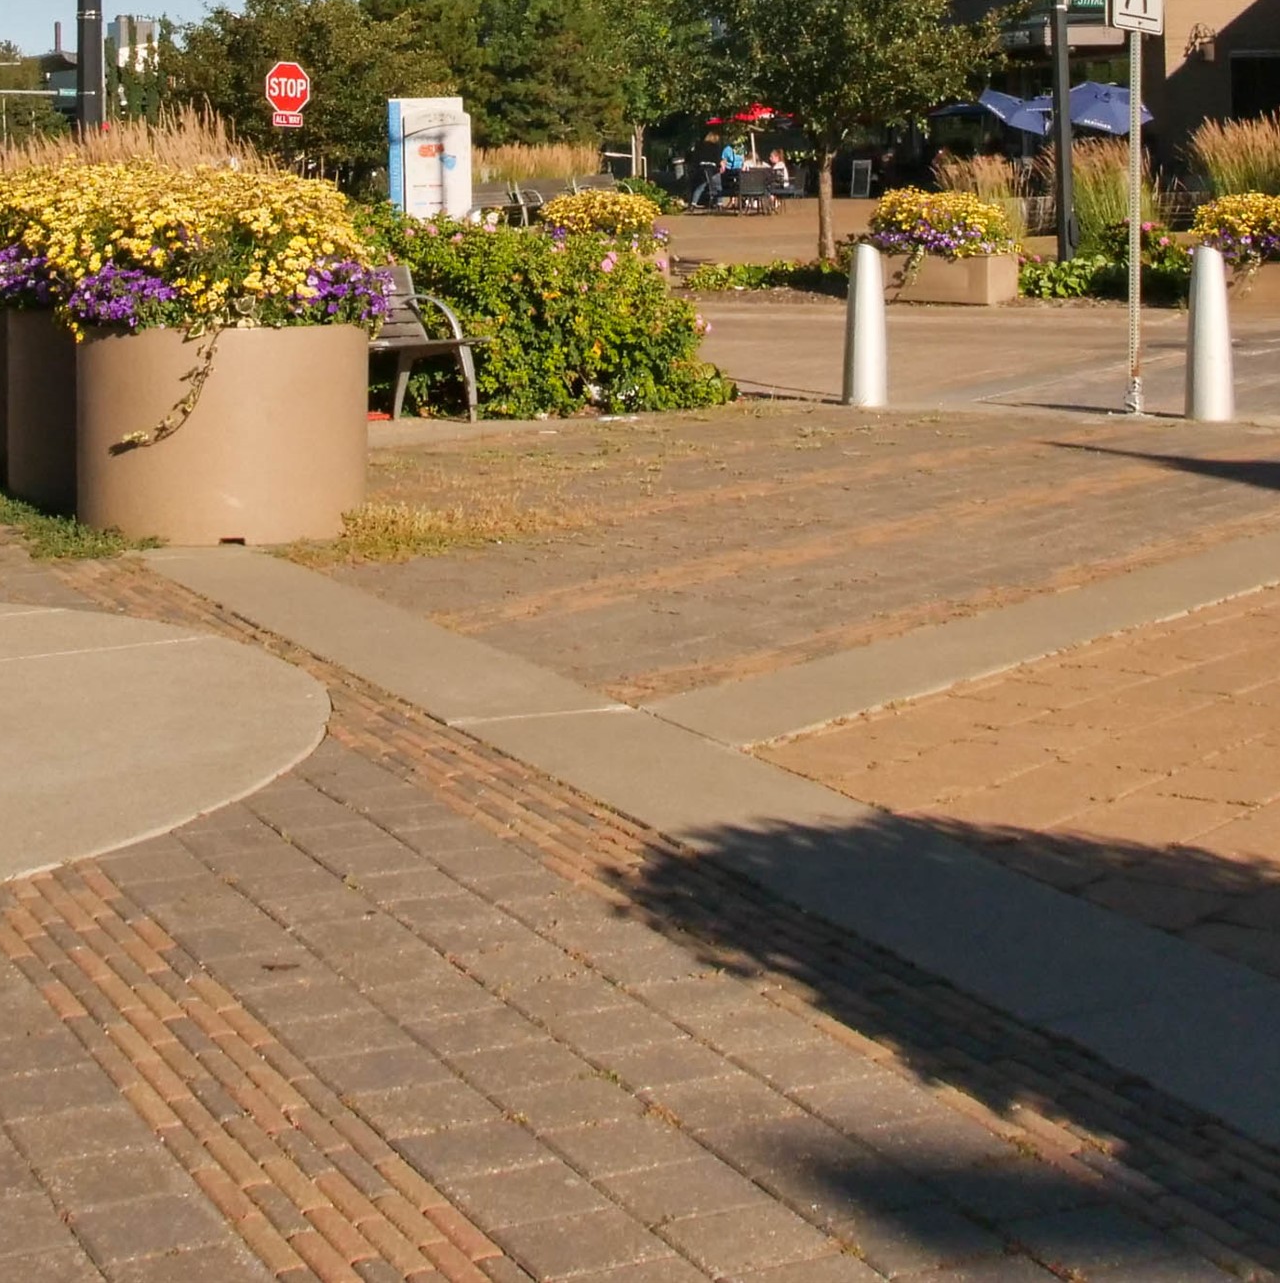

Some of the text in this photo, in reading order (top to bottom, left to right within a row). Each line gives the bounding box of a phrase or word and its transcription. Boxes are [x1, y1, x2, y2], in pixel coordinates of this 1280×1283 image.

[270, 77, 307, 98] STOP
[276, 115, 300, 124] ALL WAY
